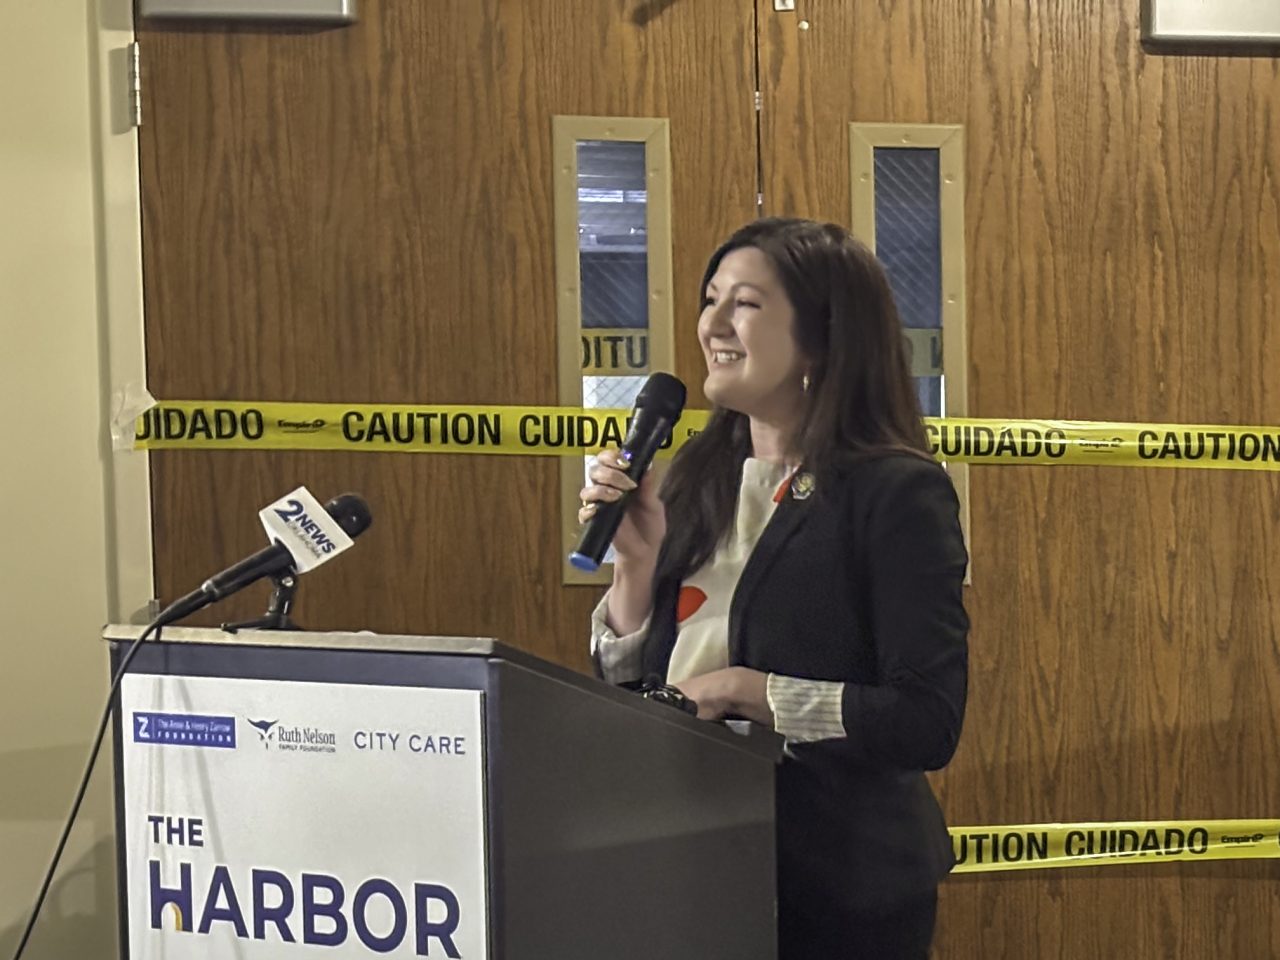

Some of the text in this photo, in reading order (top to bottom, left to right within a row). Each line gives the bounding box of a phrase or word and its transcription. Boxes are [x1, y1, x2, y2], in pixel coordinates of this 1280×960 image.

[342, 411, 501, 445] CAUTION
[519, 415, 673, 449] CUIDA
[924, 424, 1066, 458] CUIDADO
[274, 499, 304, 522] 2
[295, 514, 336, 554] NEWS
[278, 726, 336, 745] Ruth Nelson
[354, 731, 466, 755] CITY CARE
[148, 814, 204, 847] THE
[1065, 828, 1209, 860] CUIDADO
[149, 860, 462, 960] HARBOR
